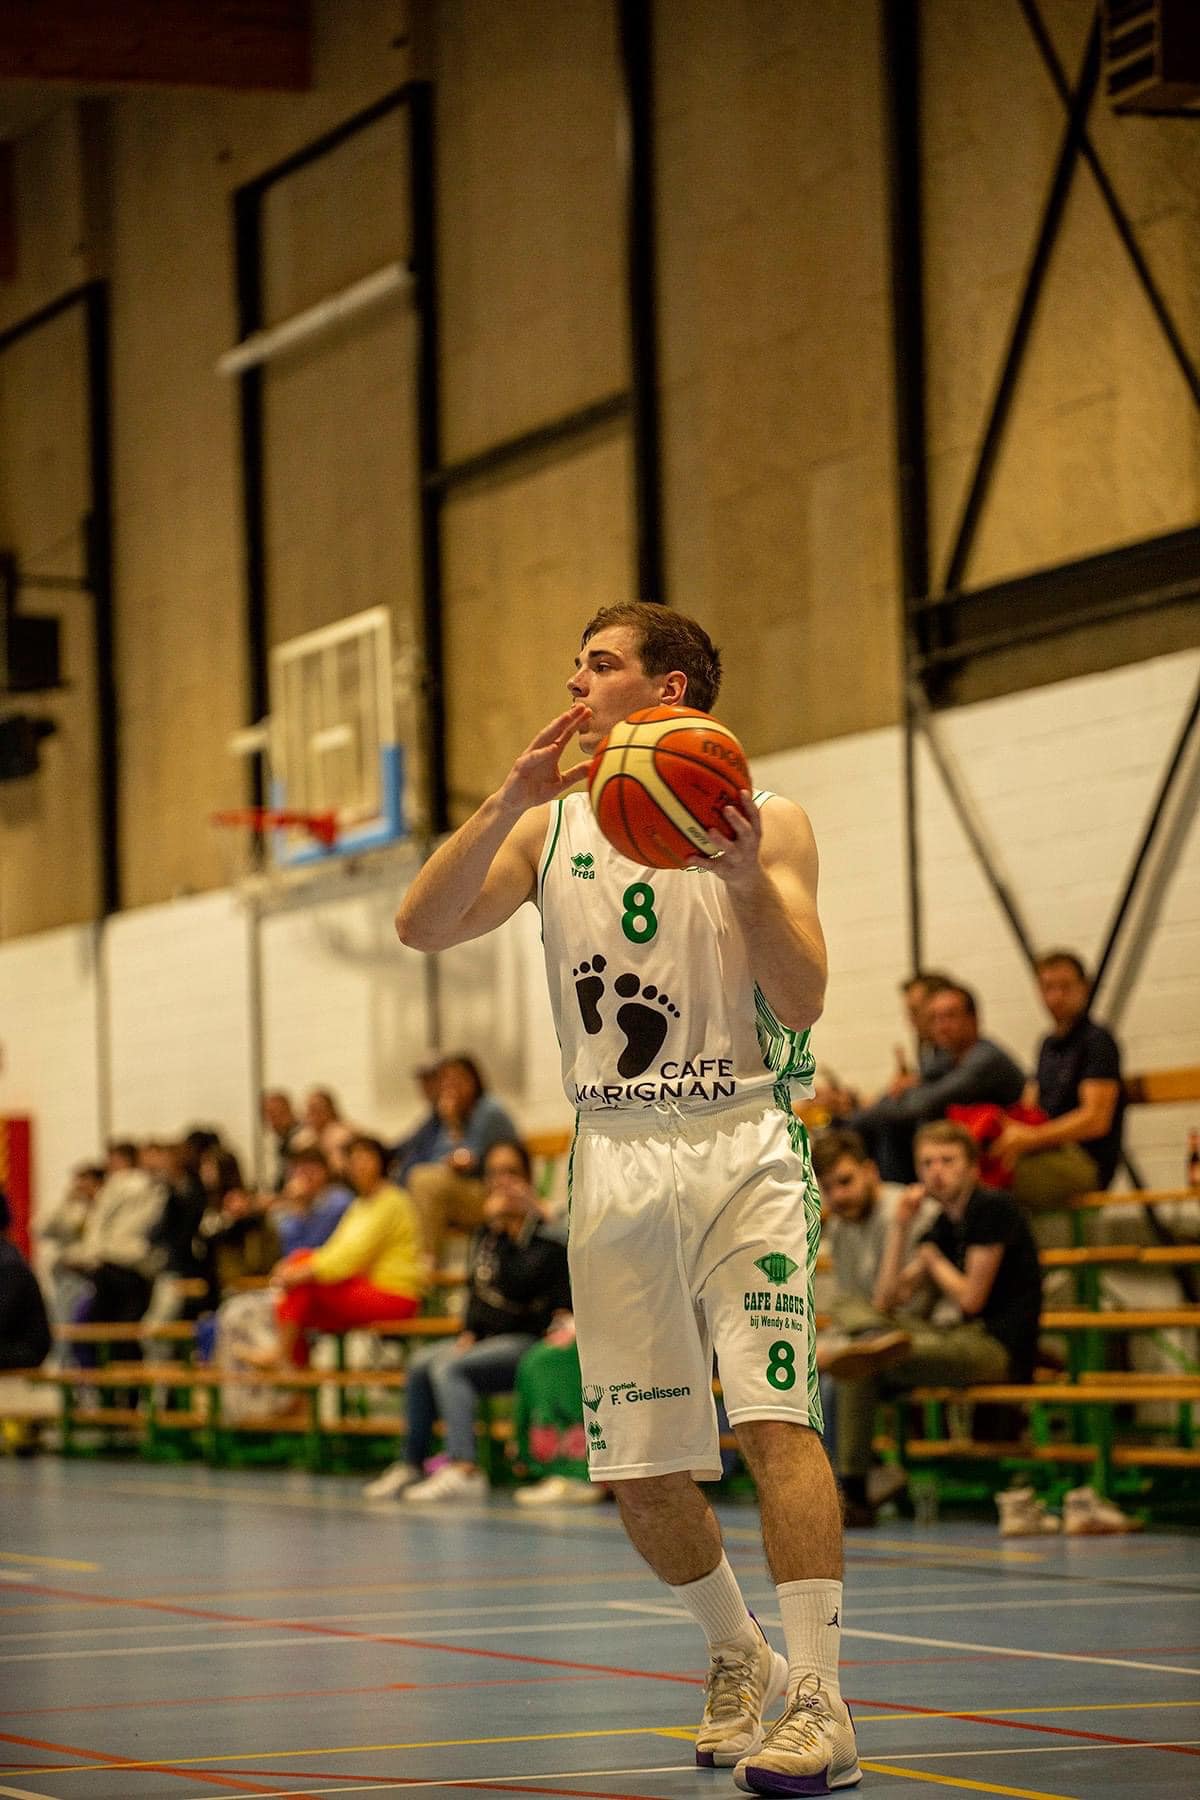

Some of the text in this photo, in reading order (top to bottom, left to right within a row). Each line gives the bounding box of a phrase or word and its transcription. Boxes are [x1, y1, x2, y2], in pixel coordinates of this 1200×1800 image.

[621, 882, 658, 944] 8
[660, 1059, 734, 1080] CAFE
[575, 1081, 736, 1104] MARIGNAN
[744, 1292, 804, 1316] CAFE ARGUS
[750, 1316, 759, 1329] bij
[761, 1316, 783, 1331] Wendy
[784, 1317, 790, 1328] &
[766, 1340, 796, 1391] 8
[608, 1381, 637, 1393] Optiek
[611, 1386, 690, 1406] F. Gielissen
